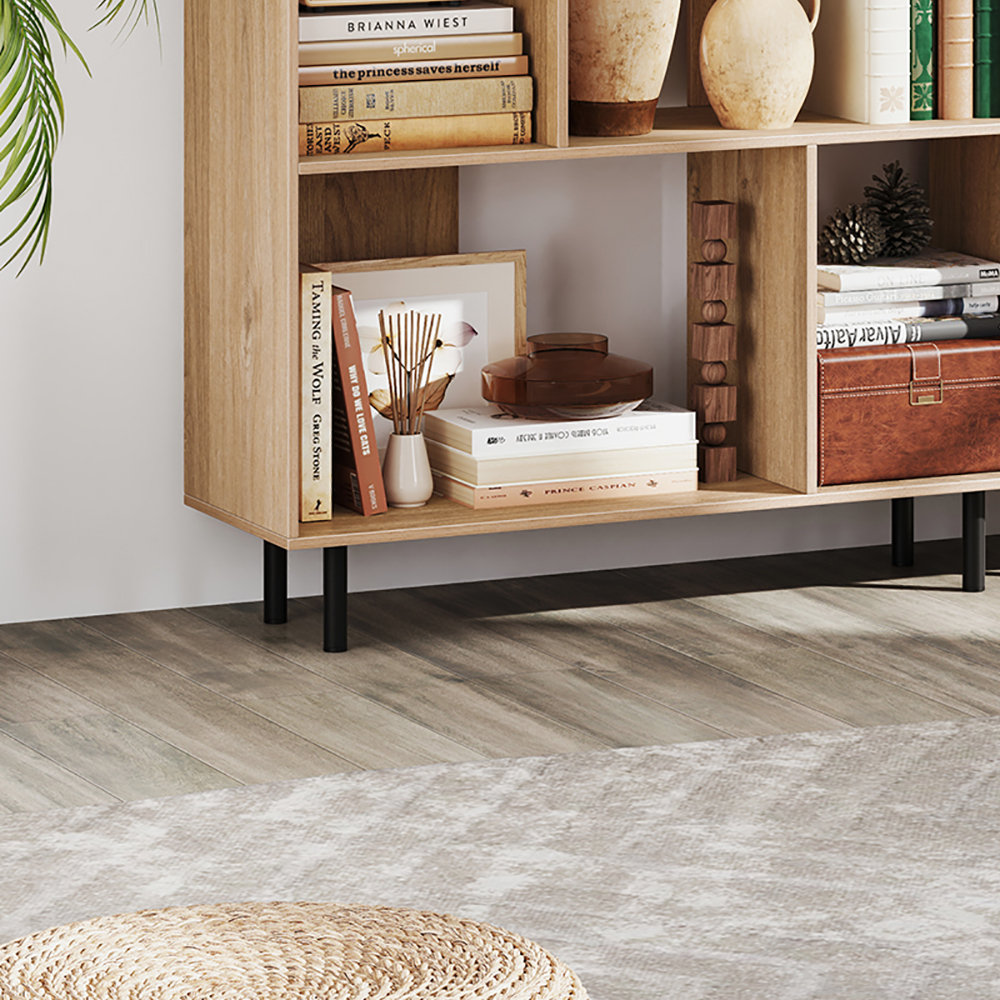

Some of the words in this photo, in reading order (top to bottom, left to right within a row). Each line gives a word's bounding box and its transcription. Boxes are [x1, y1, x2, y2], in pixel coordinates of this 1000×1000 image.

[347, 20, 417, 33] BRIANNA
[424, 16, 468, 28] WIEST
[393, 41, 436, 56] spherical
[333, 69, 355, 79] the
[357, 66, 414, 80] princess
[415, 65, 453, 75] saves
[454, 61, 500, 73] herself
[315, 125, 323, 154] EAST
[324, 126, 332, 153] AND
[311, 280, 324, 340] TAMING
[859, 325, 901, 343] Alvar
[312, 343, 321, 360] the
[311, 361, 324, 405] WOLF
[348, 364, 358, 384] WHY
[351, 384, 361, 396] DO
[354, 397, 364, 413] WE
[312, 413, 323, 444] GREG
[356, 413, 367, 435] LOVE
[361, 435, 371, 456] CATS
[312, 446, 322, 481] STONE
[544, 485, 583, 495] PRINCE
[589, 482, 637, 492] CASPIAN
